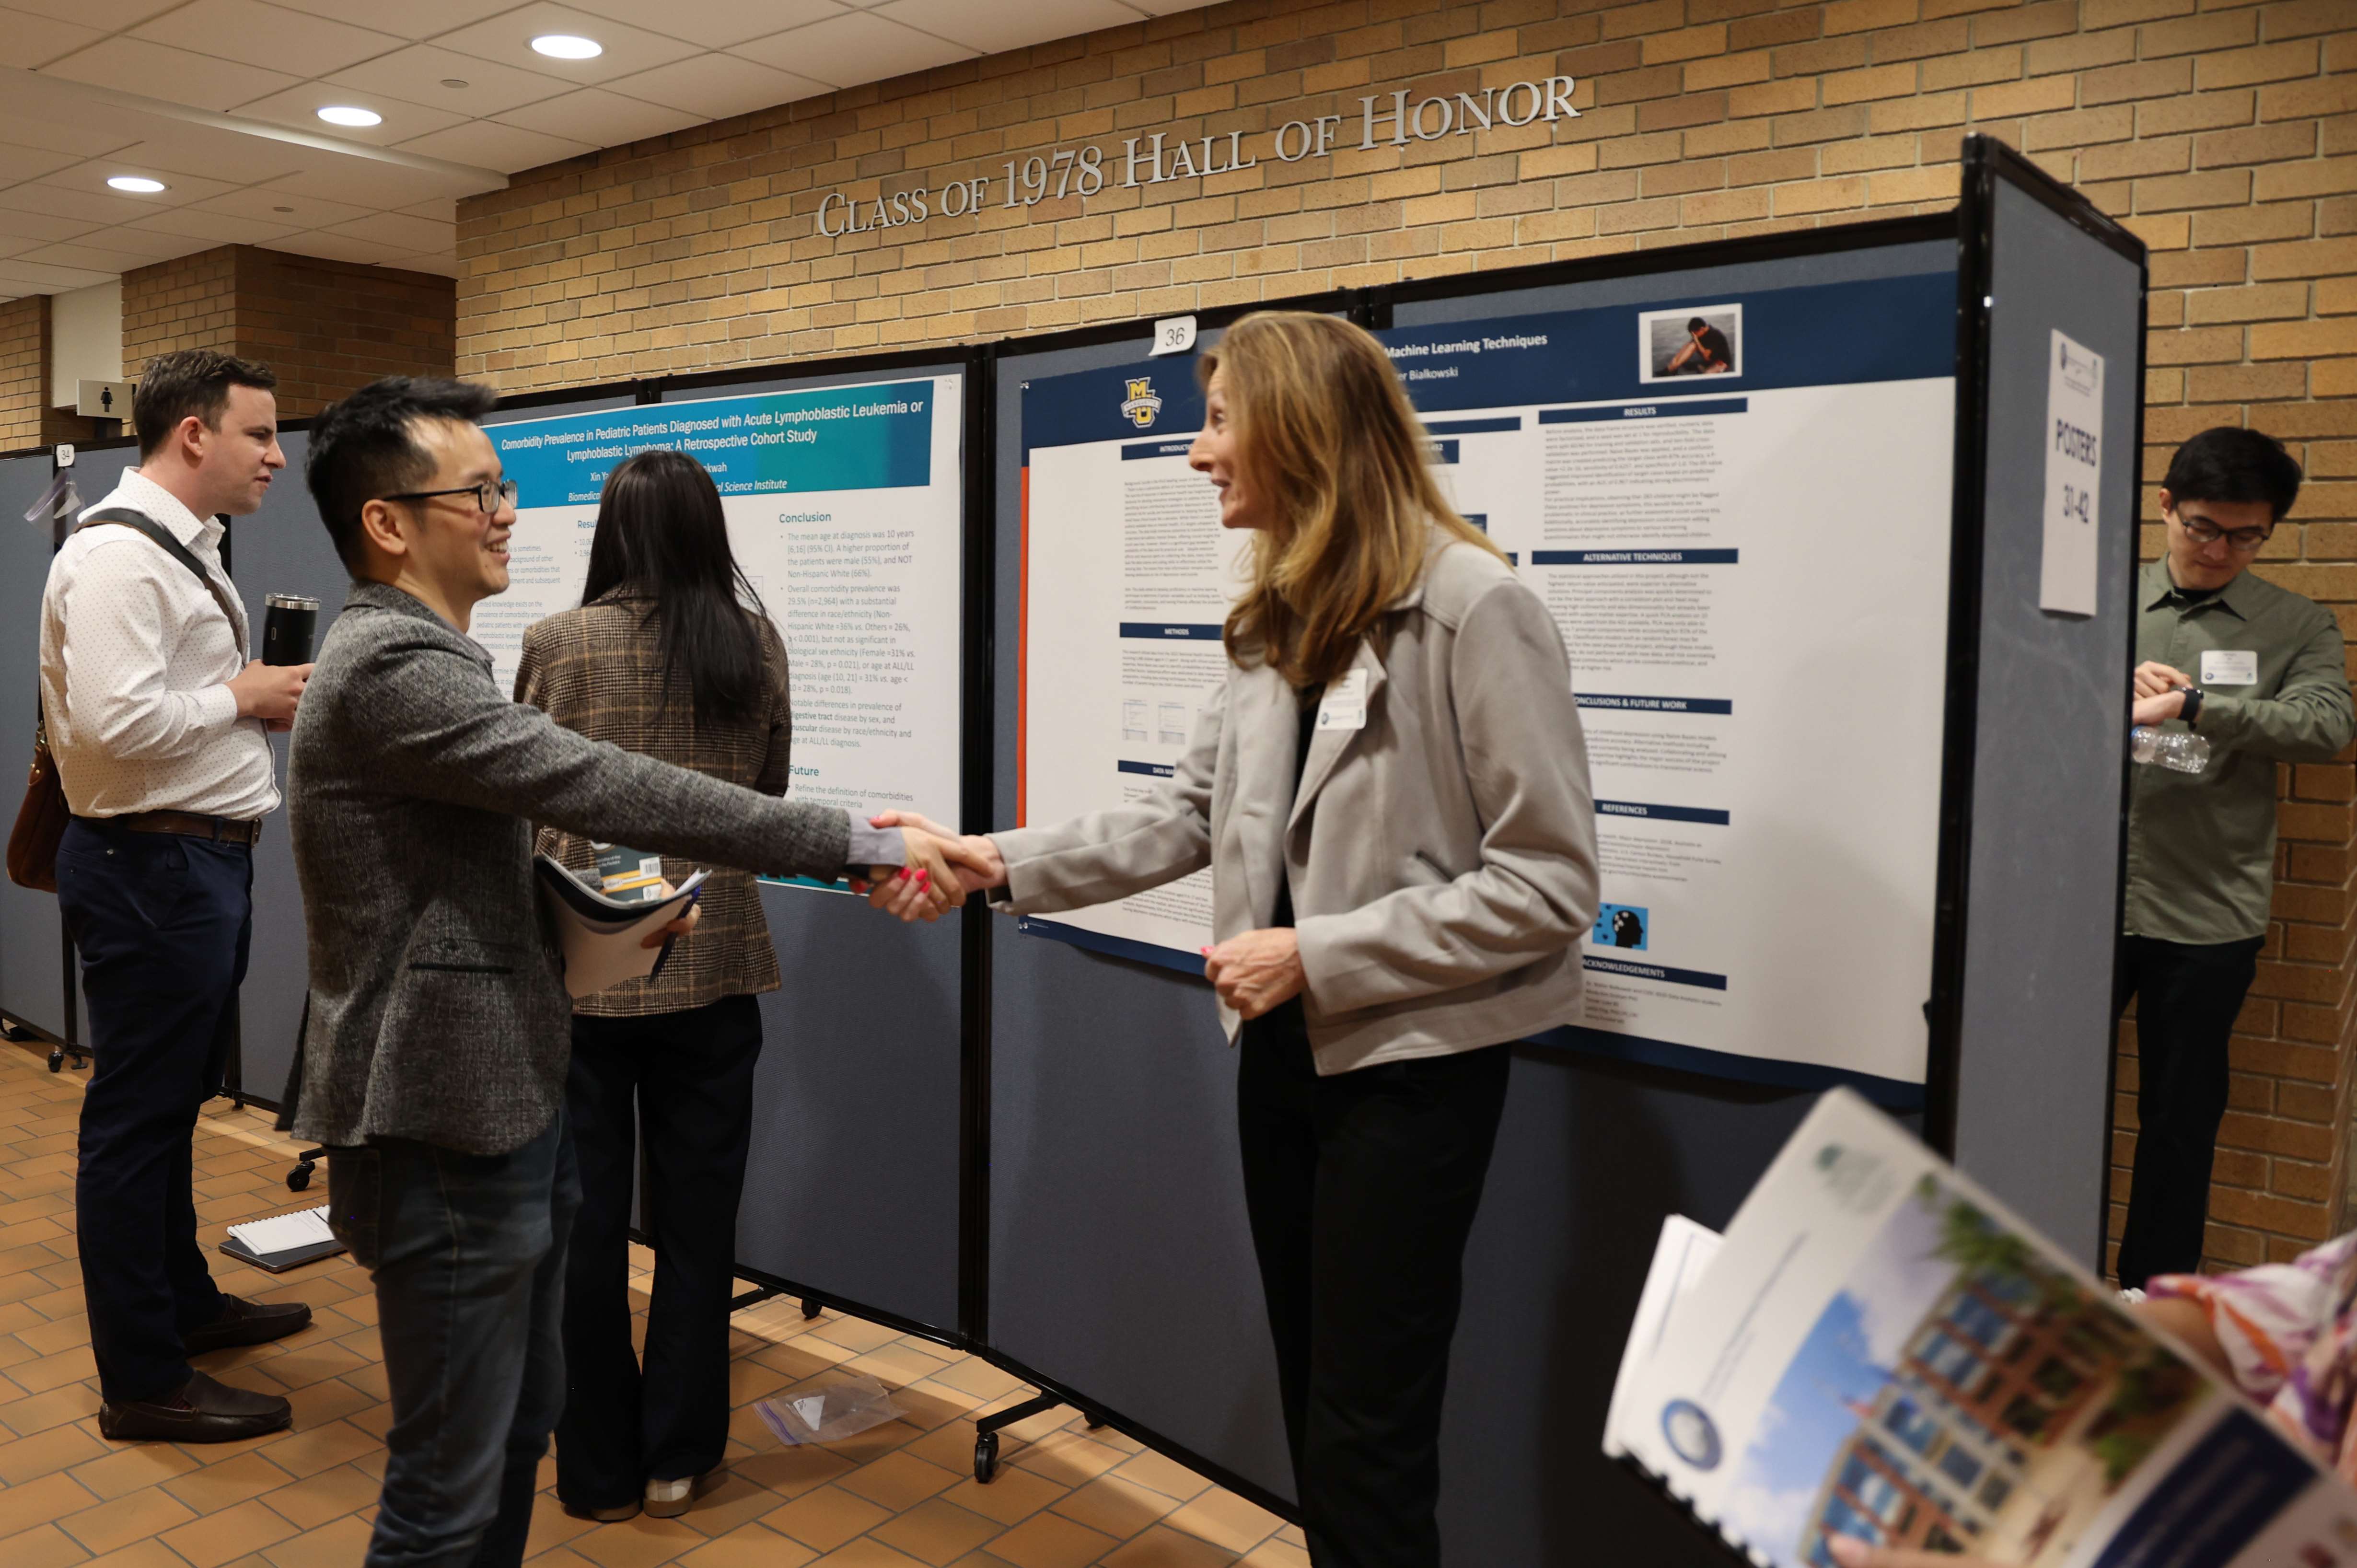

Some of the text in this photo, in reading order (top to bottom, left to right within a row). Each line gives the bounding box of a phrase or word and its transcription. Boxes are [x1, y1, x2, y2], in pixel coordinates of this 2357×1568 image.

[817, 75, 1581, 237] CLASS OF 1978 HALL OF HONOR
[1166, 327, 1184, 347] 36
[1384, 335, 1548, 359] Machine Learning Techniques
[1409, 367, 1459, 381] Bialkowski
[1624, 406, 1656, 417] RESULTS
[502, 400, 923, 451] Comorbidity Prevalence in Pediatric Patients Diagnosed with Acute Lymphoblastic Leukemia or
[567, 429, 817, 463] Lymphoblastic Lymphoma: A Retrospective Cohort Study
[2056, 418, 2096, 467] POSTERS
[591, 472, 600, 481] Xin
[724, 482, 753, 492] Science
[754, 480, 788, 491] Institute
[2065, 484, 2089, 523] 31-42
[779, 512, 831, 523] Conclusion
[840, 533, 871, 541] diagnosis
[843, 545, 863, 553] higher
[1583, 552, 1682, 562] ALTERNATIVE TECHNIQUES
[850, 585, 886, 593] prevalence
[855, 636, 888, 645] significant
[788, 648, 817, 656] biological
[829, 649, 858, 657] ethnicity
[871, 663, 883, 671] age
[789, 673, 816, 681] diagnosis
[891, 676, 902, 685] age
[814, 700, 848, 708] differences
[857, 702, 894, 711] prevalence
[894, 703, 902, 711] of
[1575, 697, 1687, 710] ONCLUSIONS & FUTURE WORK
[834, 714, 858, 722] disease
[859, 715, 867, 723] by
[819, 725, 842, 733] disease
[843, 727, 851, 735] by
[789, 765, 819, 776] Future
[795, 784, 814, 793] Refine
[827, 787, 858, 796] definition
[859, 789, 867, 797] of
[868, 790, 913, 801] comorbidities
[809, 798, 839, 807] temporal
[1602, 803, 1648, 815] REFERENCES
[1583, 959, 1665, 978] ACKNOWLEDGEMENTS
